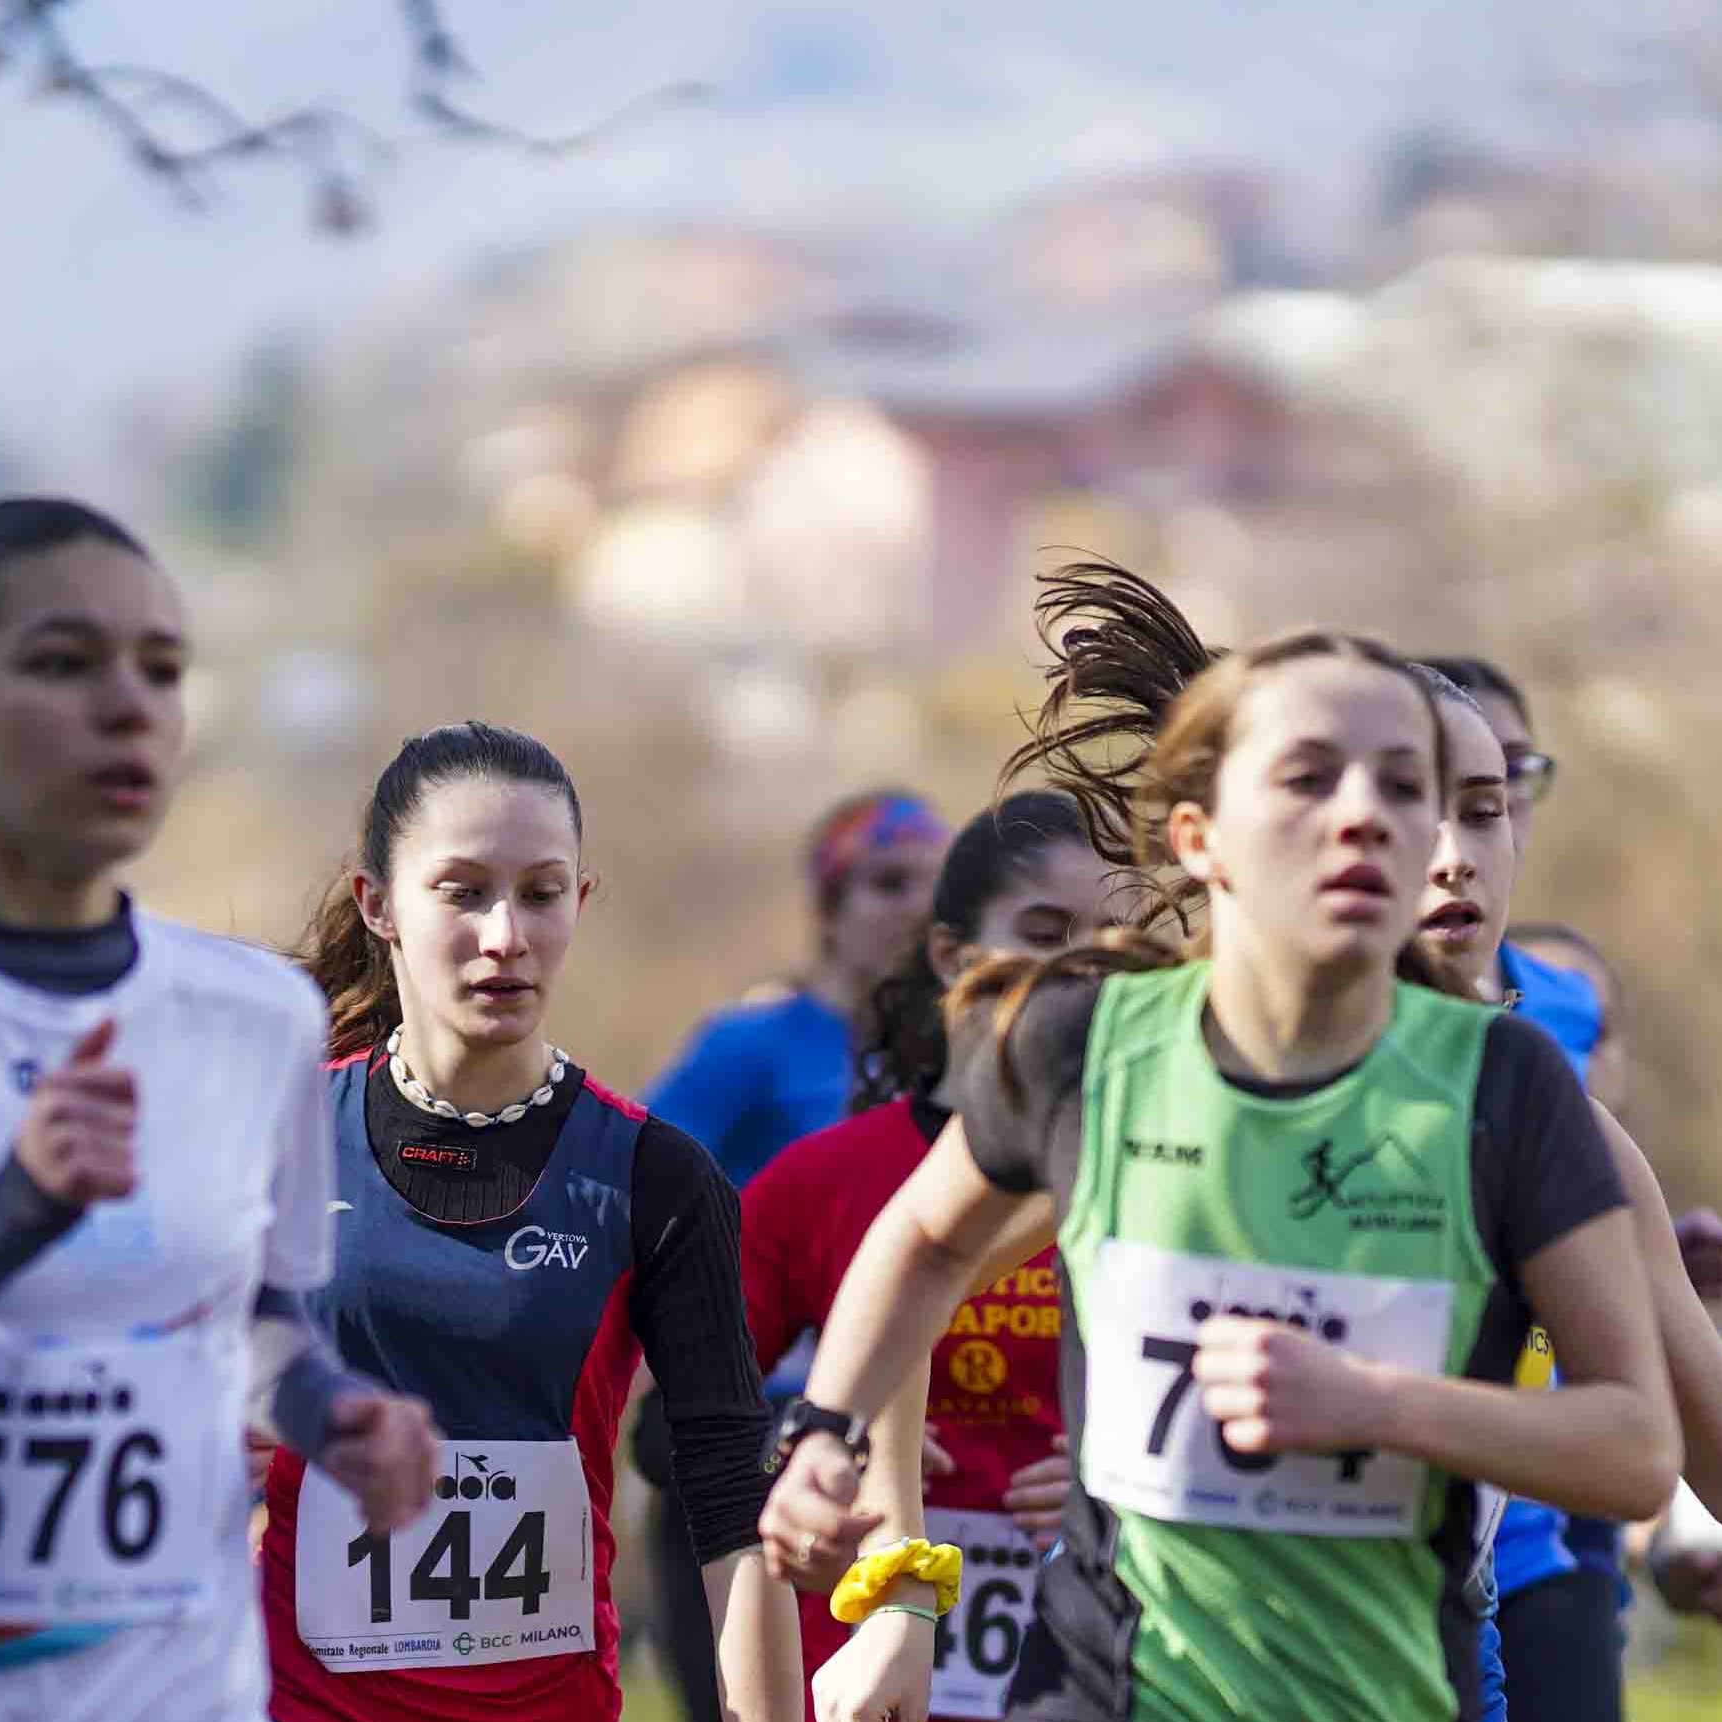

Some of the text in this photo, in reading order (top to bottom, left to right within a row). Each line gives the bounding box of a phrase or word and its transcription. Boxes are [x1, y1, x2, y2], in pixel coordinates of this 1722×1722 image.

[401, 1146, 455, 1166] CRAFT
[504, 1225, 589, 1271] GAV
[547, 1231, 588, 1244] VERTOVA
[434, 1451, 517, 1501] dora
[347, 1510, 551, 1624] 144
[348, 1642, 389, 1659] Regionale
[394, 1638, 442, 1654] LOMBARDIA
[480, 1624, 581, 1649] BCC MILANO
